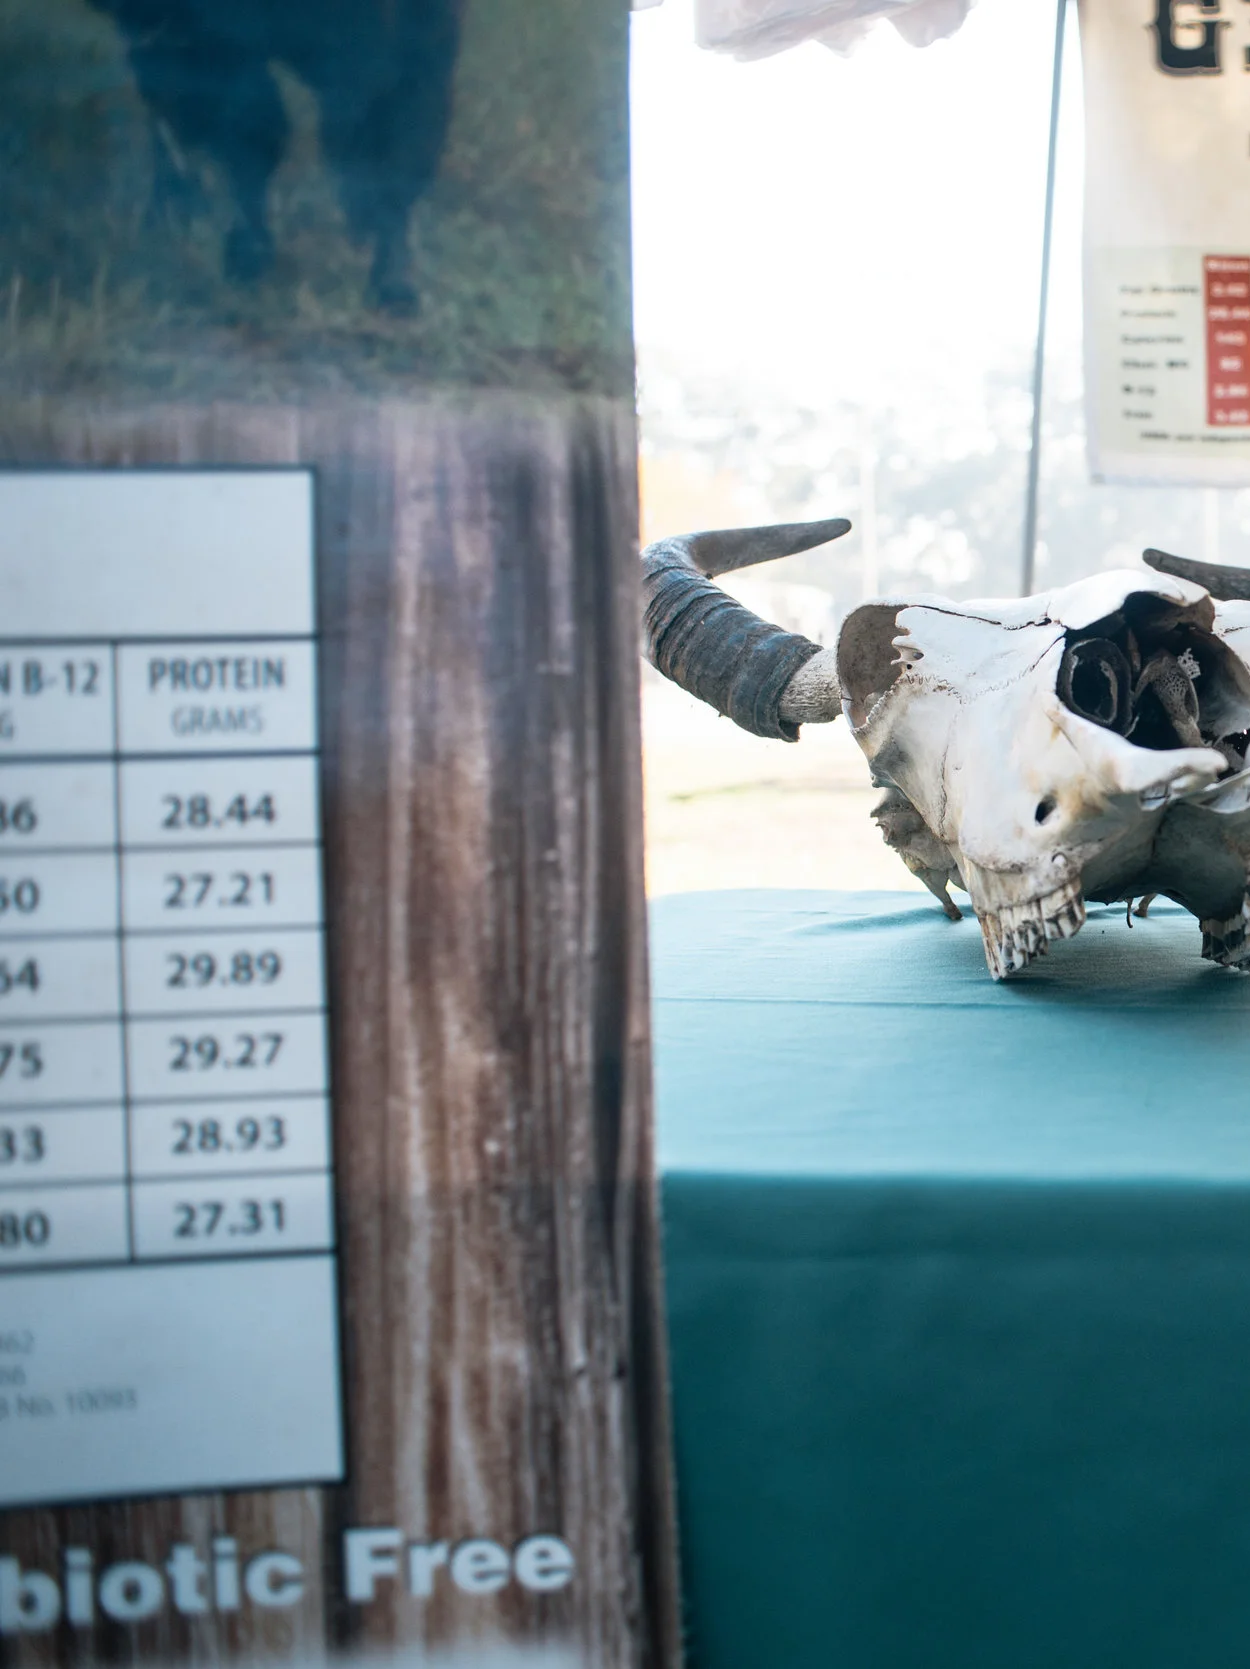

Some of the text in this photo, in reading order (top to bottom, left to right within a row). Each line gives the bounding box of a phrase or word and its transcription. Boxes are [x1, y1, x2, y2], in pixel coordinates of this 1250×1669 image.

[22, 659, 99, 696] B-12
[148, 656, 286, 695] PROTEIN
[170, 704, 265, 737] GRAMS
[161, 793, 277, 831] 28.44
[163, 873, 276, 910] 27.21
[165, 950, 282, 990] 29.89
[169, 1033, 284, 1074] 29.27
[171, 1115, 287, 1156] 28.93
[173, 1199, 287, 1240] 27.31
[0, 1526, 577, 1635] biotic Free
